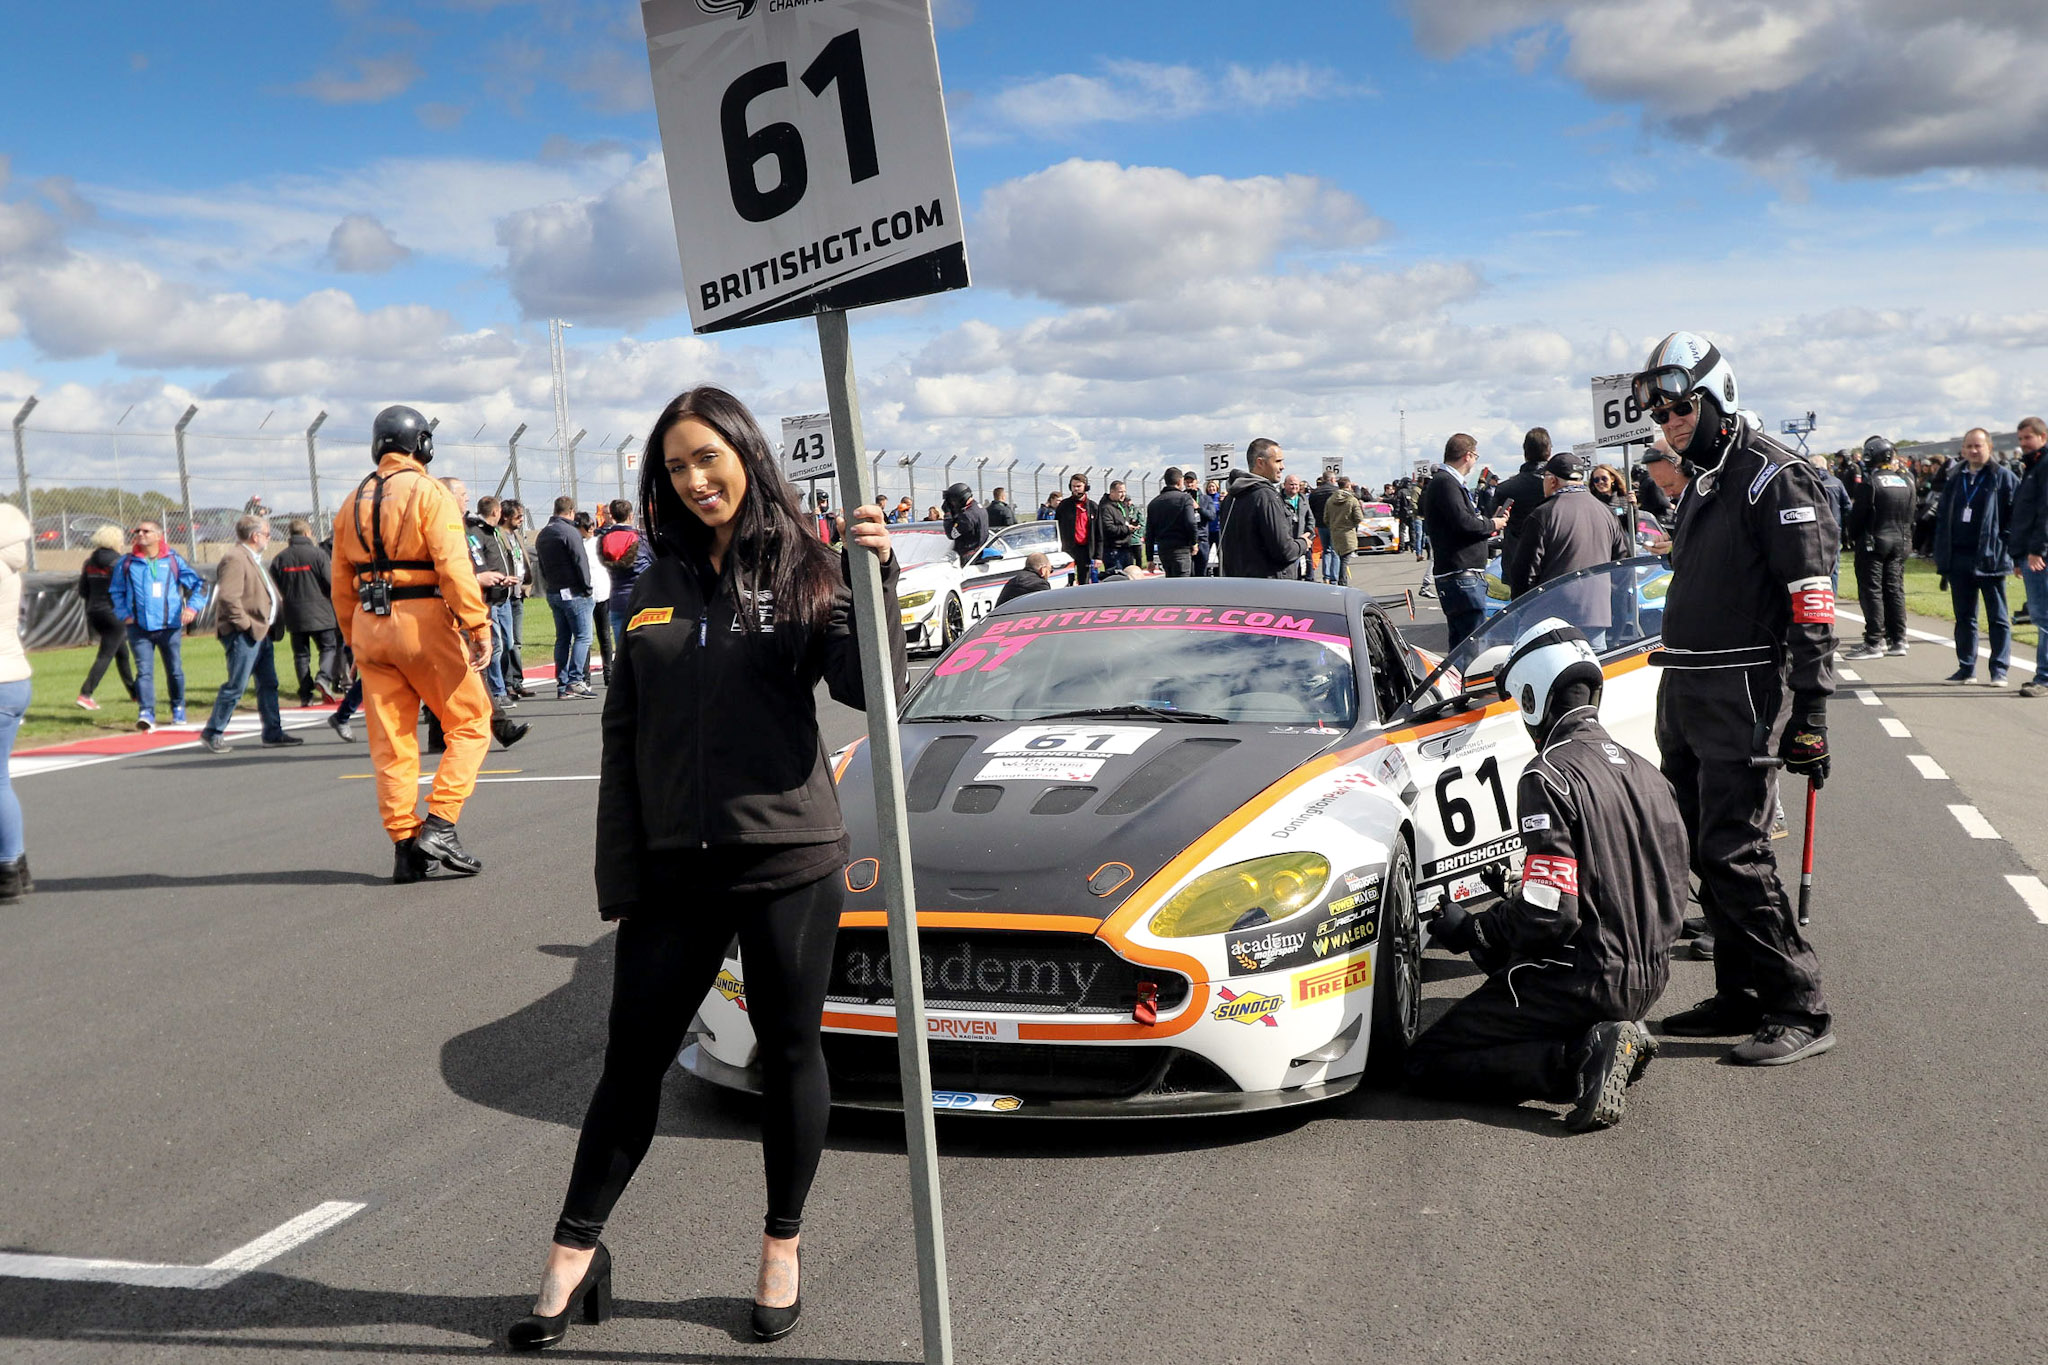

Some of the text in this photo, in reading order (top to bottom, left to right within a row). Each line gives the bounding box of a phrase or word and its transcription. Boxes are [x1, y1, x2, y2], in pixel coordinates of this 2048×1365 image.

[720, 28, 880, 223] 61
[700, 199, 944, 311] BRITISHGT.COM
[1604, 395, 1642, 429] 66
[792, 433, 825, 463] 43
[1599, 427, 1651, 444] BRITISHGT.COM
[628, 456, 636, 468] F
[789, 463, 833, 479] BRITISHGT.COM
[1210, 454, 1229, 472] 55
[982, 608, 1314, 637] BRITISHGT.COM
[1025, 733, 1115, 750] 61
[1435, 756, 1512, 847] 61
[1436, 837, 1522, 874] BRITISHGT.CO
[1331, 921, 1374, 949] WALERO
[714, 976, 744, 995] UNOCO
[1300, 961, 1366, 1001] PIRELLI
[1217, 998, 1280, 1018] SUNOCO
[927, 1018, 997, 1038] DRIVEN
